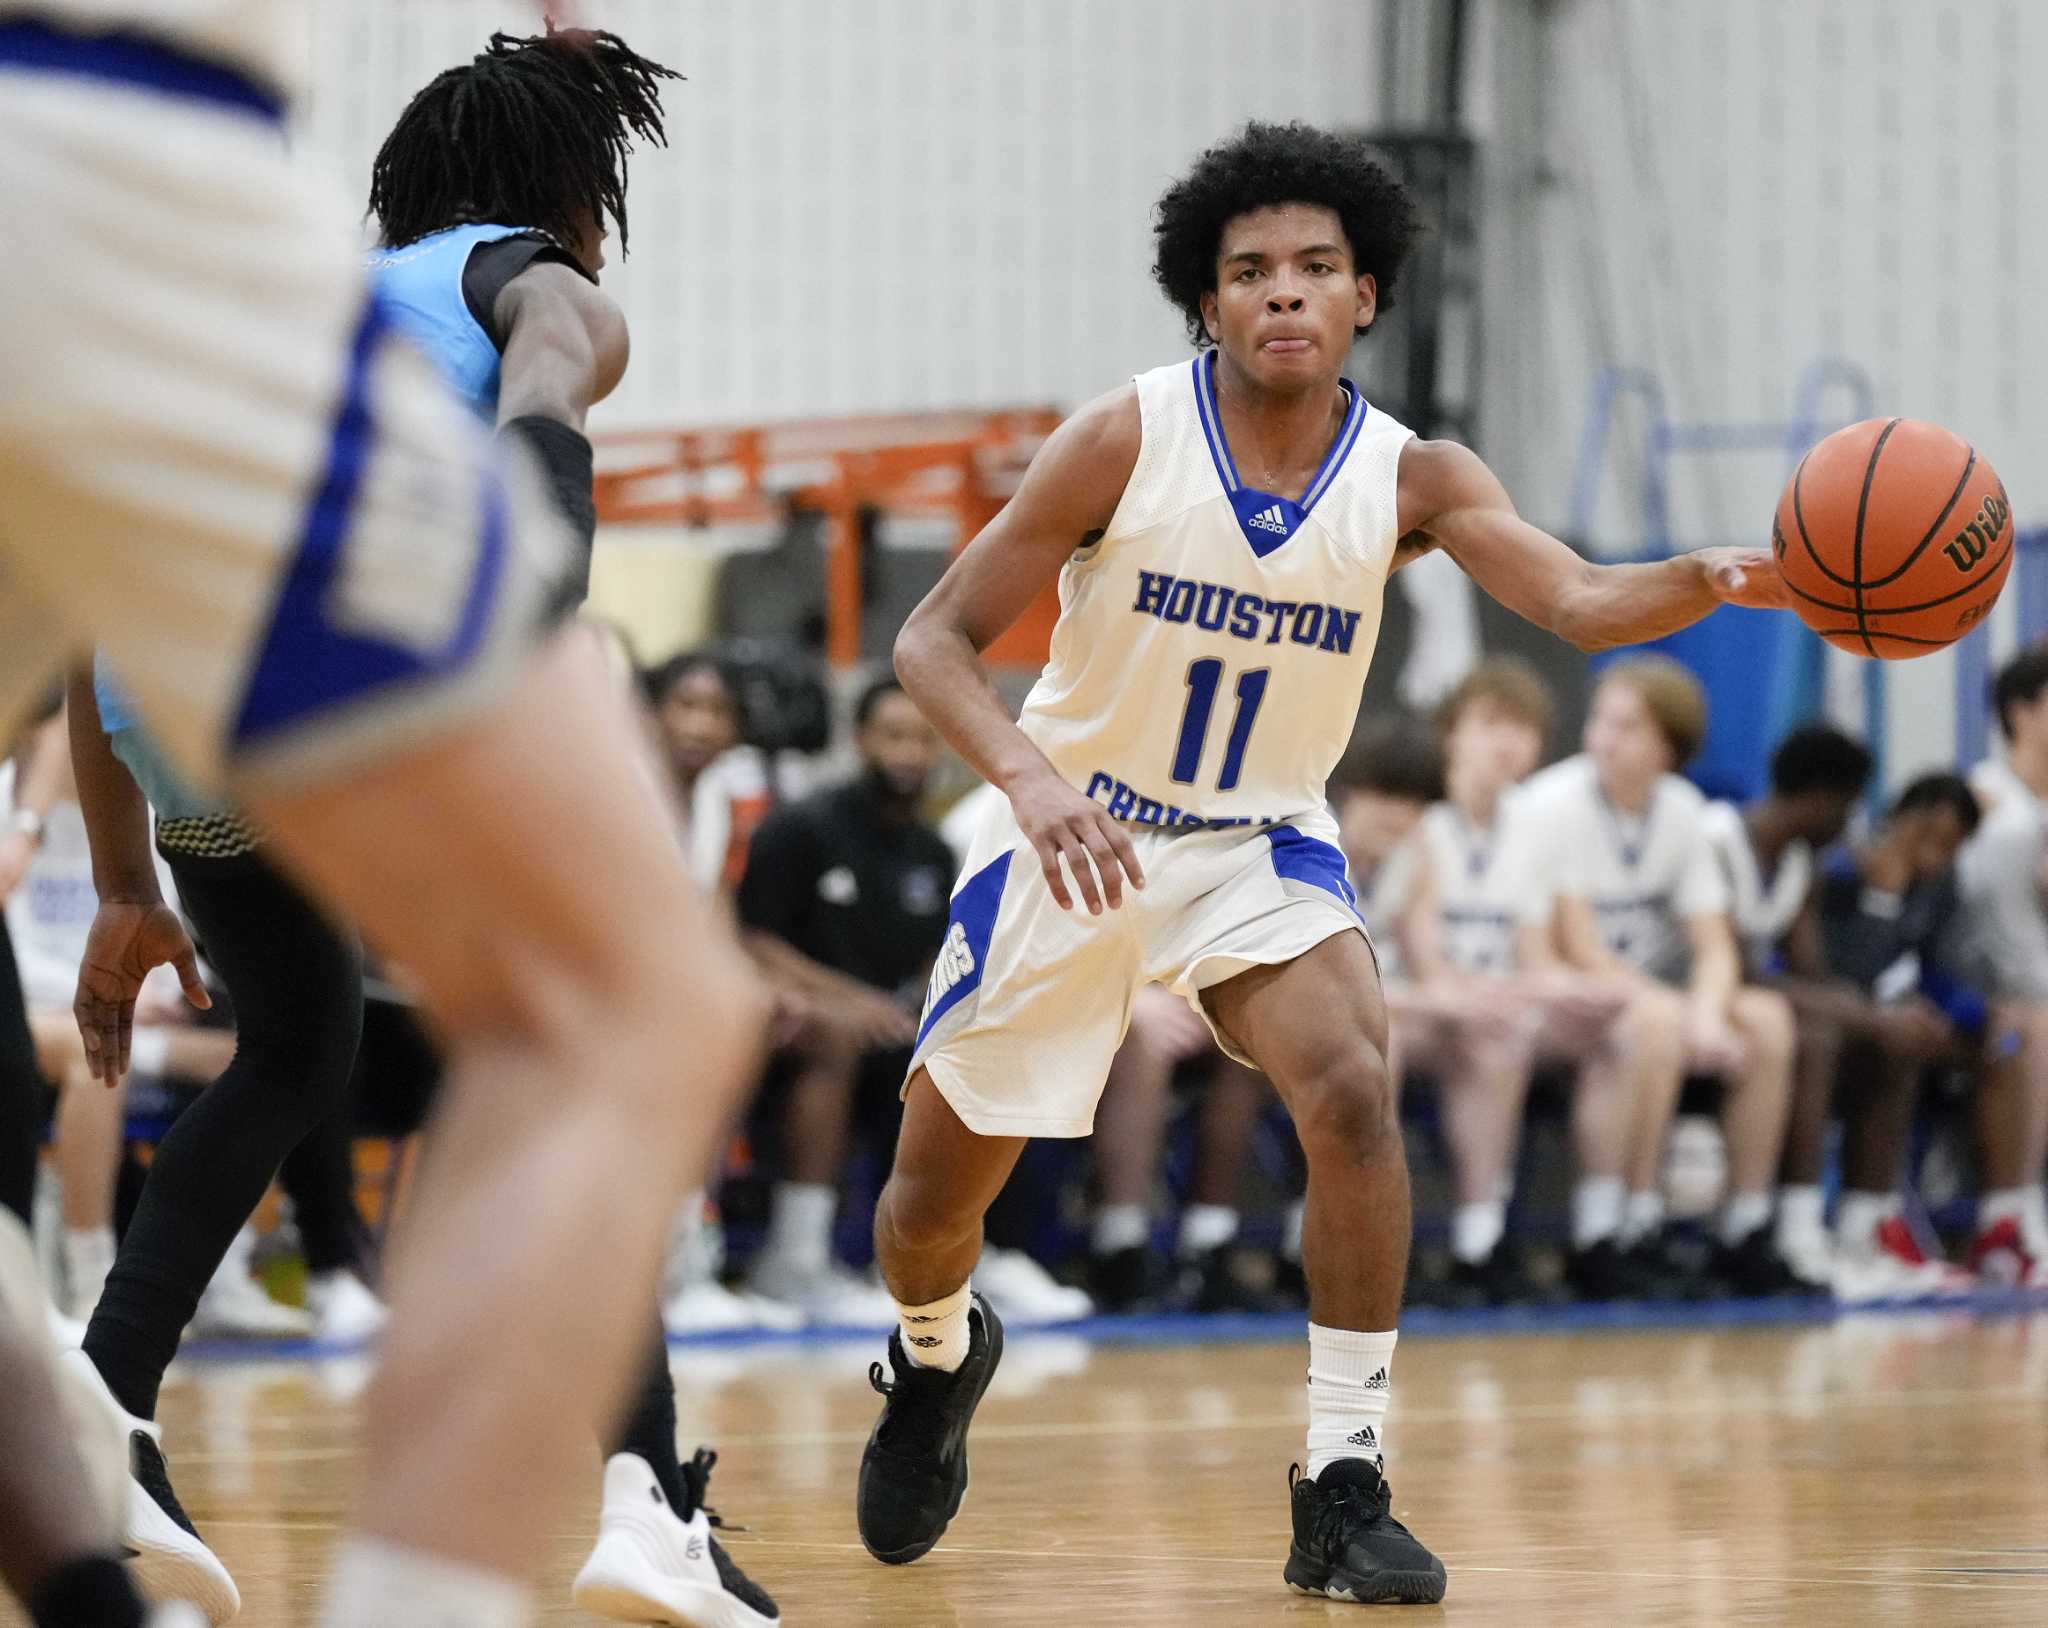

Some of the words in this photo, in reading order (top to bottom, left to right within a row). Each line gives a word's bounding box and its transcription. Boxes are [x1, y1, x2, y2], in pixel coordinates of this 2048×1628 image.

[1248, 518, 1288, 535] adidas
[1132, 568, 1361, 656] HOUSTON
[1169, 655, 1272, 793] 11
